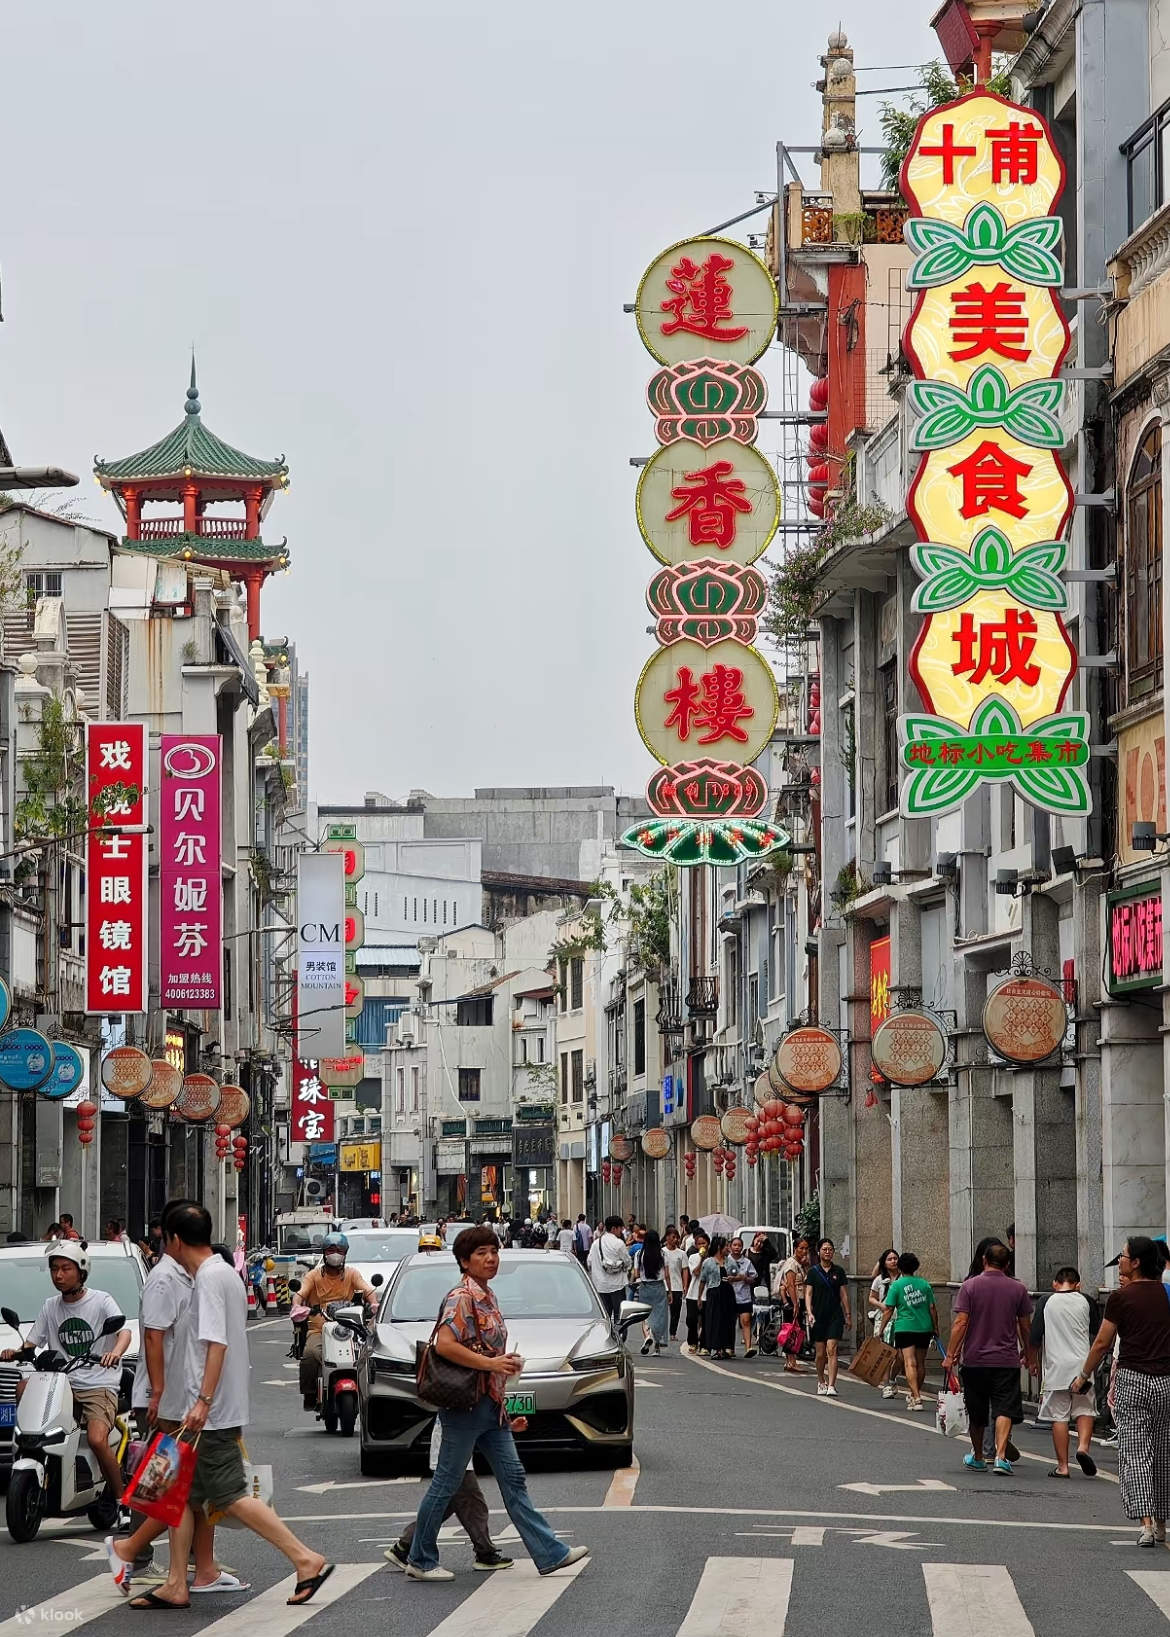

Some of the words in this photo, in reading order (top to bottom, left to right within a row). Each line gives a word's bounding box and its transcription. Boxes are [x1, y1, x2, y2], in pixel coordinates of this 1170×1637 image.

[918, 121, 1044, 185] 十甫
[909, 740, 1082, 766] 地标小吃集市
[173, 788, 208, 957] 贝尔妮芬
[300, 923, 340, 943] CM
[305, 961, 337, 972] 男装馆
[167, 972, 213, 984] 加盟热线
[165, 988, 216, 999] 4006123383
